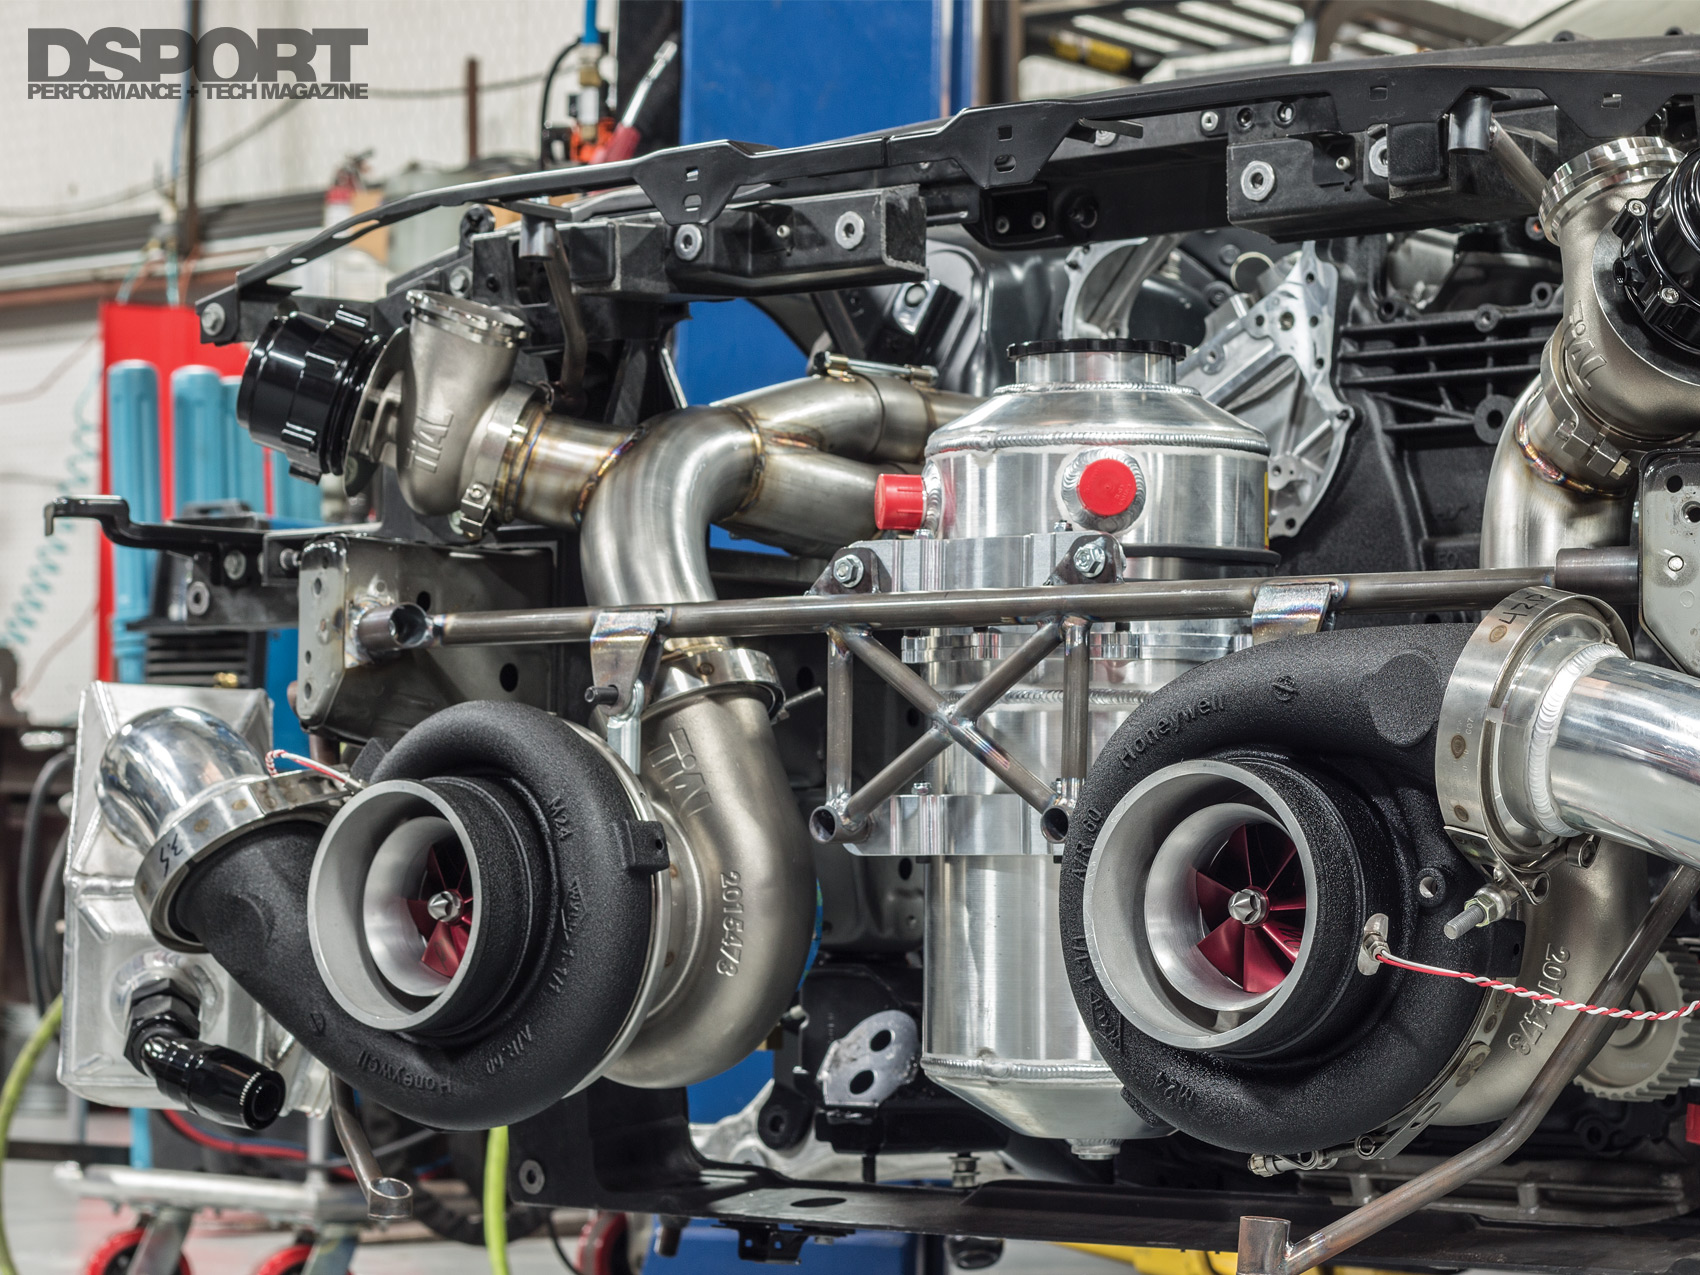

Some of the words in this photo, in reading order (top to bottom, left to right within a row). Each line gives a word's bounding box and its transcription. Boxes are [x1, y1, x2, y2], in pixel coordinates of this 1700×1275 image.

[1118, 694, 1224, 769] Honeywell
[716, 870, 745, 977] 2015473
[356, 1050, 453, 1094] Honeywell
